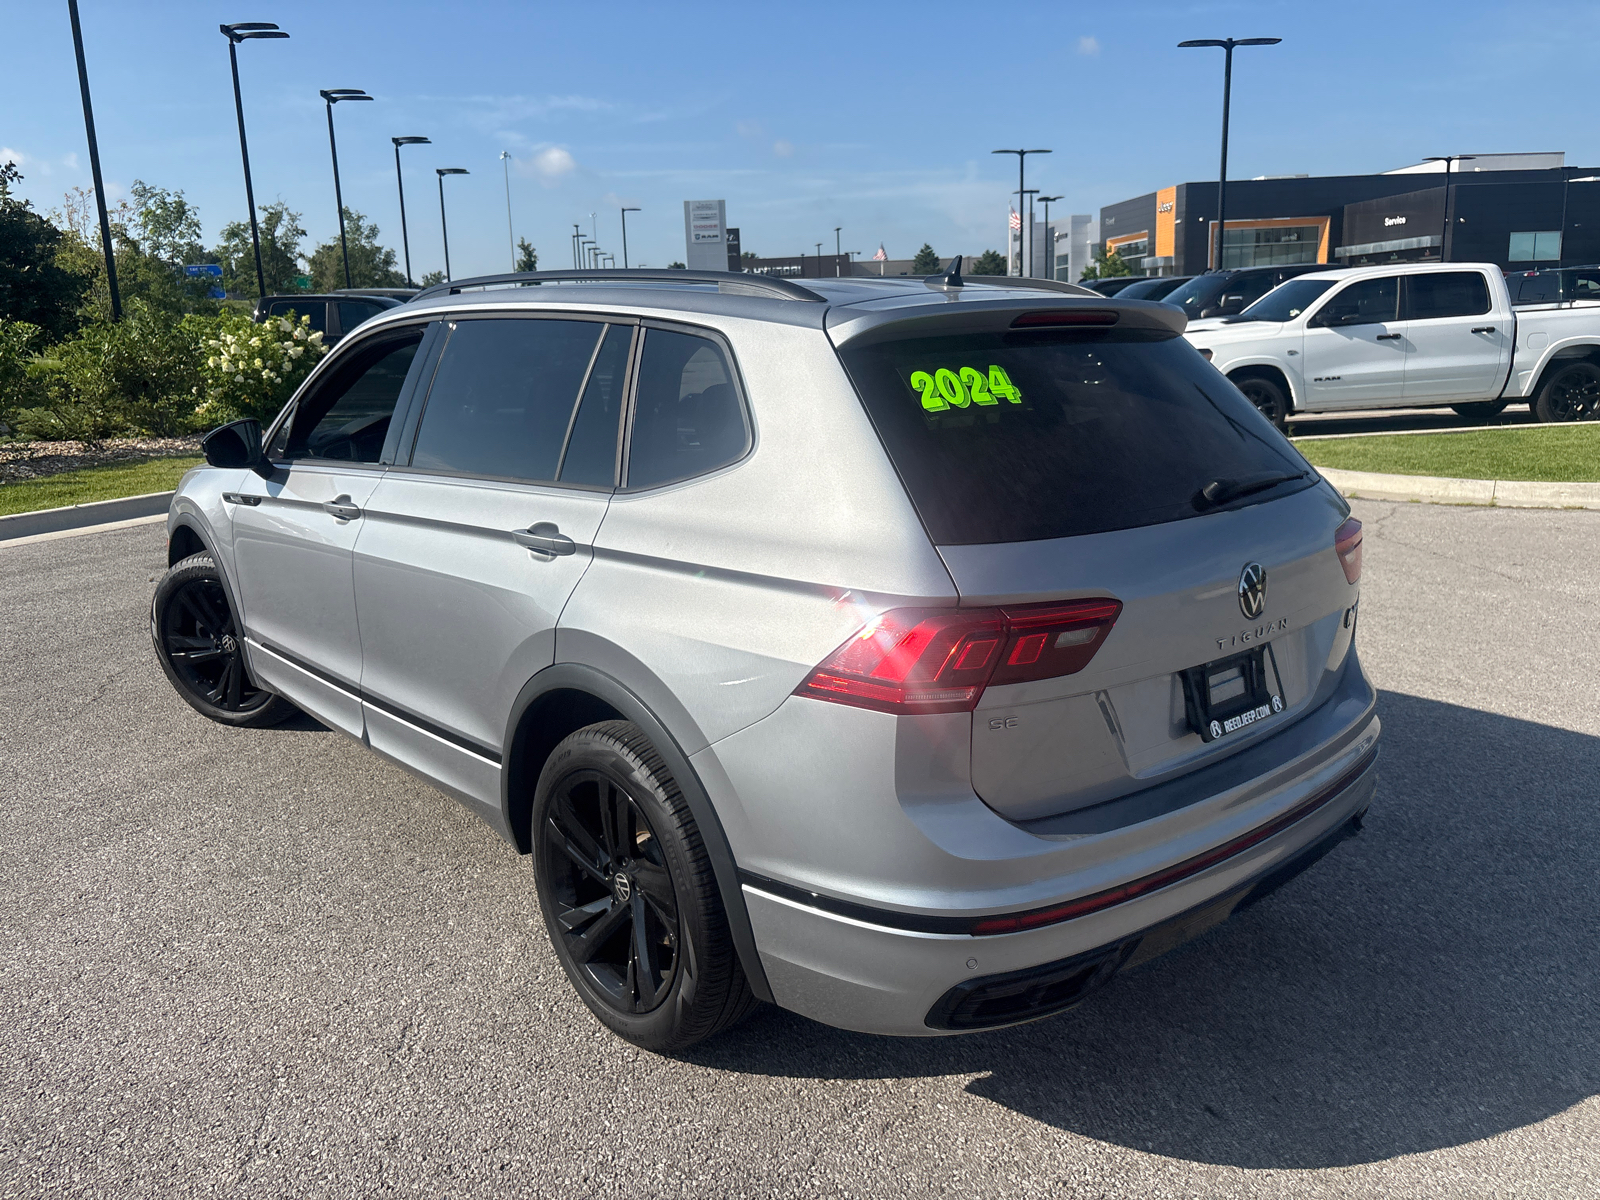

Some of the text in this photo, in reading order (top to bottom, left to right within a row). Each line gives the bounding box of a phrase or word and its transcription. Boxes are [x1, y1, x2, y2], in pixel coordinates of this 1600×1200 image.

[1384, 215, 1406, 227] Service
[910, 364, 1022, 413] 2024
[1216, 618, 1288, 649] TIGUAN
[988, 715, 1018, 730] SE
[1223, 703, 1271, 733] REEDJEEP.COM
